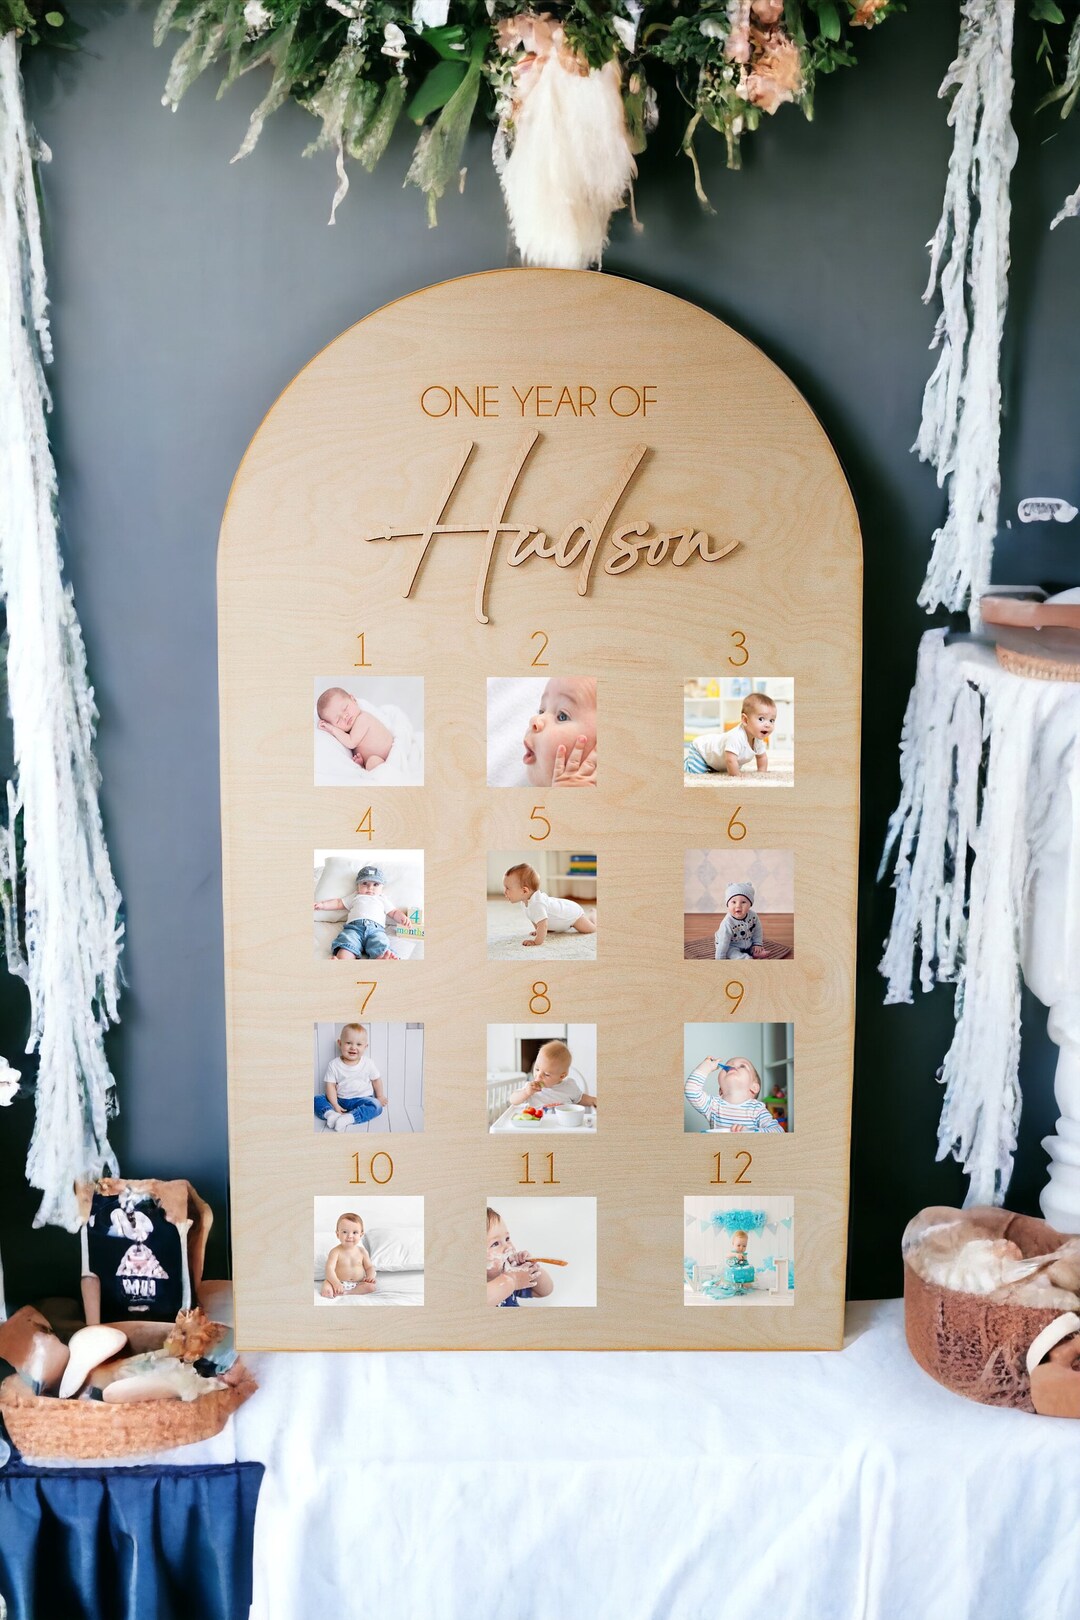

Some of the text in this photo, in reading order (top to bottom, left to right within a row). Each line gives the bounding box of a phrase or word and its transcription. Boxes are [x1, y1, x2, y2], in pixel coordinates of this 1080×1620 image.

[420, 385, 657, 417] ONE YEAR OF
[365, 429, 741, 625] Hudson
[354, 631, 372, 667] 1
[530, 630, 549, 667] 2
[727, 630, 749, 667] 3
[355, 806, 376, 842] 4
[529, 806, 551, 841] 5
[726, 806, 747, 841] 6
[409, 909, 420, 924] 4
[355, 981, 377, 1015] 7
[528, 980, 551, 1015] 8
[724, 980, 745, 1015] 9
[349, 1151, 394, 1185] 10
[518, 1151, 560, 1185] 11
[709, 1151, 753, 1185] 12
